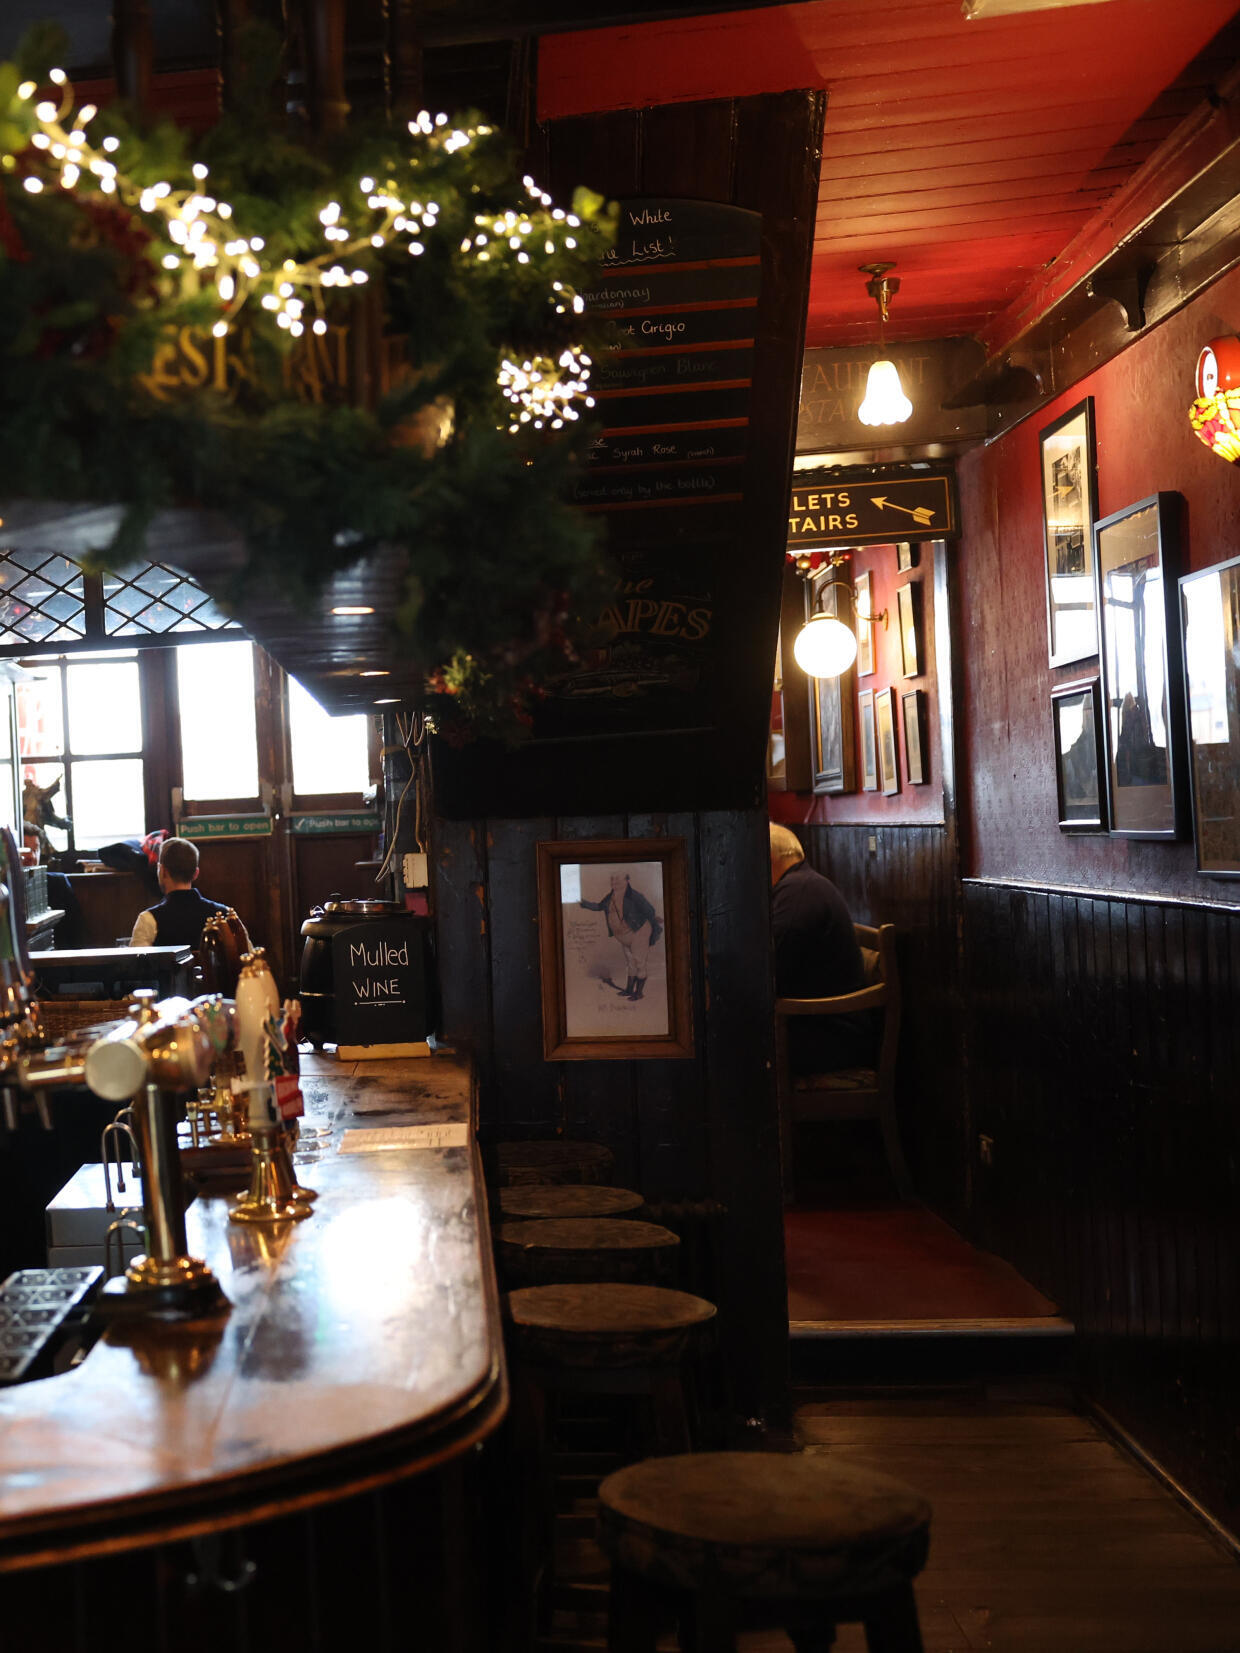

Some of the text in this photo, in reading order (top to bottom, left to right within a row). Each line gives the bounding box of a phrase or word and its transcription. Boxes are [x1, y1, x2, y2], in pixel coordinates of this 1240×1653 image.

[629, 208, 673, 225] White
[641, 319, 686, 341] Grigio
[792, 492, 851, 512] LETS
[789, 513, 859, 534] TAIRS
[180, 824, 205, 834] Push
[208, 823, 225, 832] bar
[228, 822, 240, 832] to
[349, 941, 409, 967] Mulled
